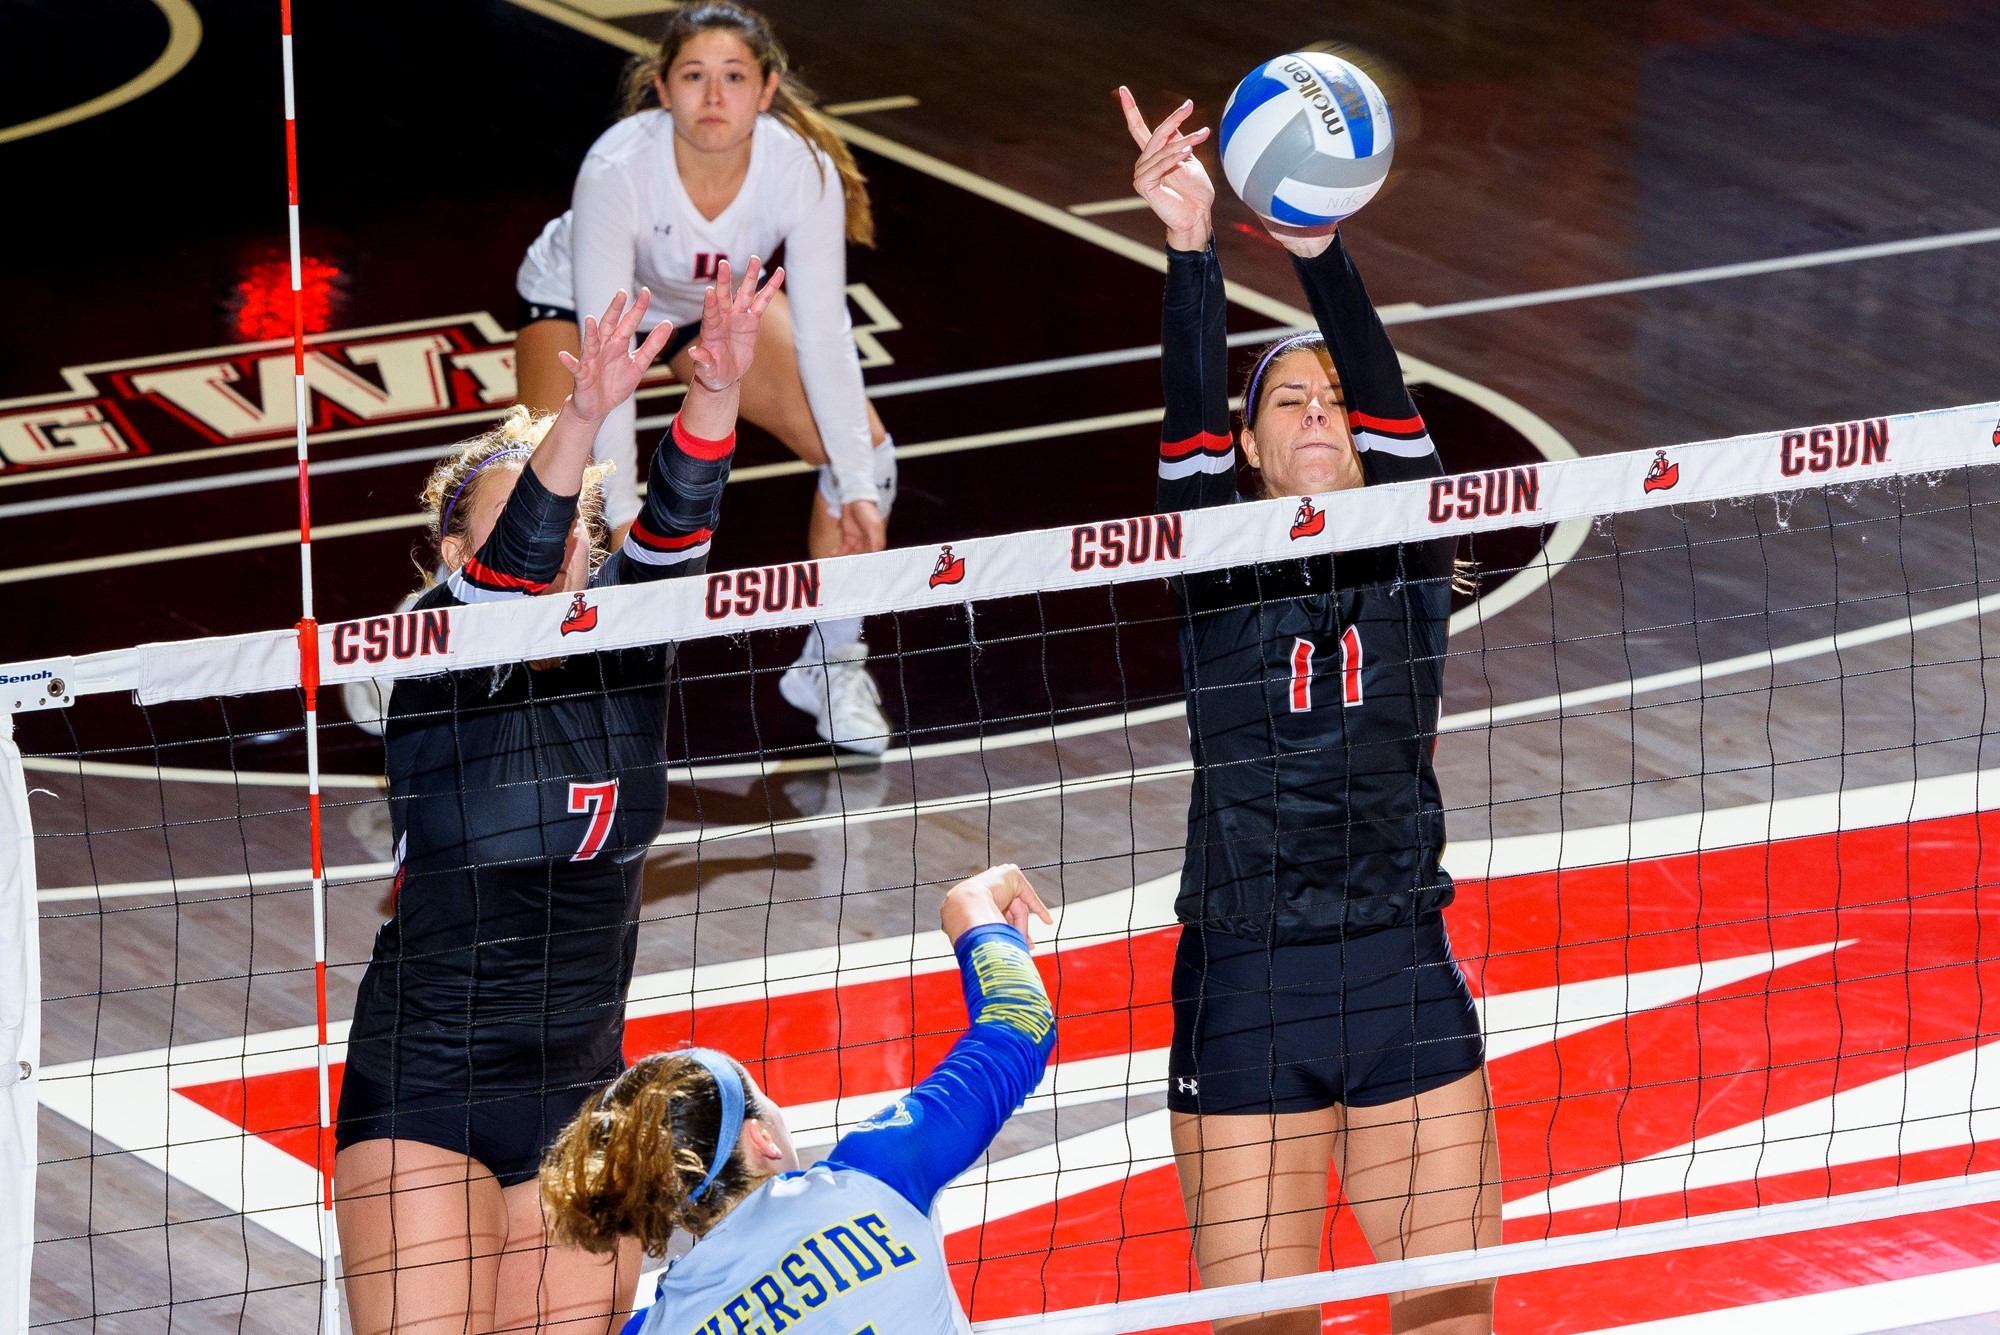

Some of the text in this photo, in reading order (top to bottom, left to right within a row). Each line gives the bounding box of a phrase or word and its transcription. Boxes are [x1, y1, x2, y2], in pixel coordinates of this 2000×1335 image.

[1284, 61, 1345, 136] molten
[1780, 417, 1889, 477] CSUN
[1428, 465, 1540, 524] CSUN
[1070, 512, 1183, 572] CSUN
[705, 562, 820, 620] CSUN
[331, 609, 451, 665] CSUN
[0, 670, 52, 684] Senoh
[1289, 623, 1363, 713] 11
[567, 778, 619, 862] 7
